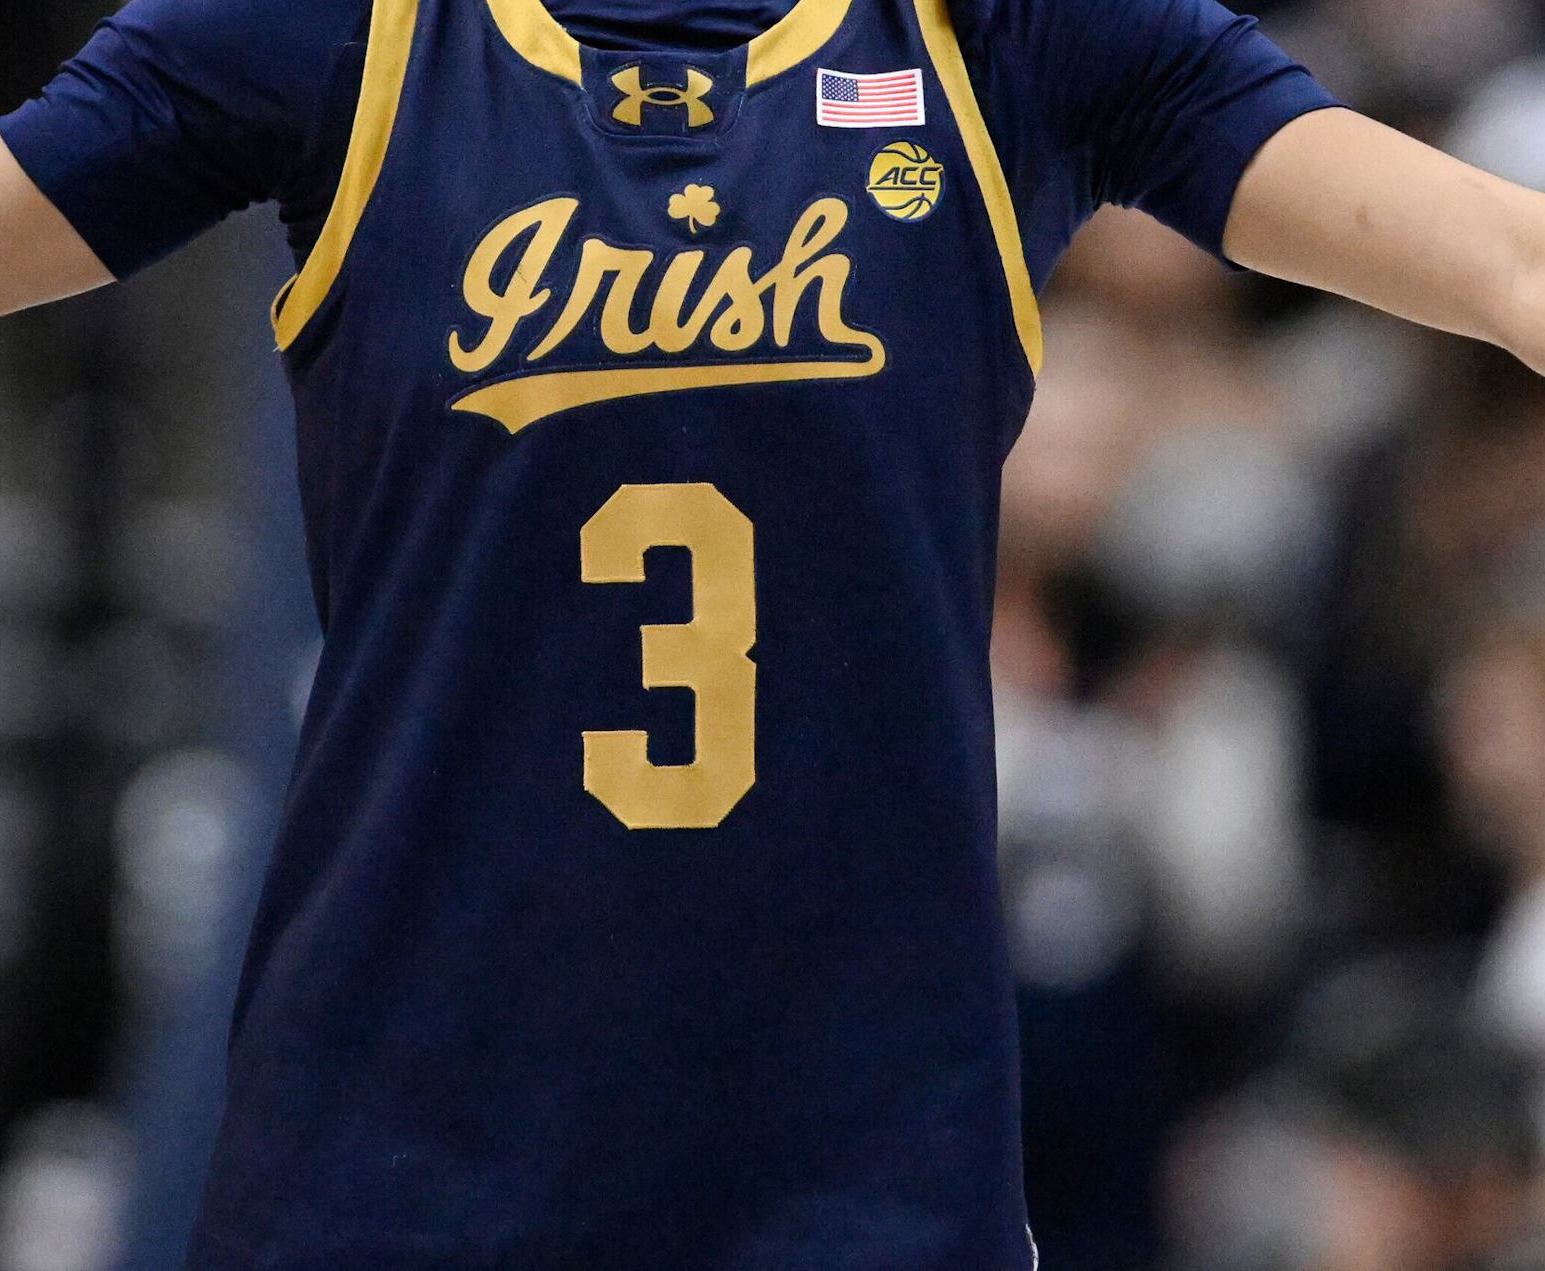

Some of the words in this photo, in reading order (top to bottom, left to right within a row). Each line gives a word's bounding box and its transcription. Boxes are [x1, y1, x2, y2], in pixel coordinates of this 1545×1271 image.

[875, 166, 943, 185] ACC
[449, 197, 886, 435] Irish
[580, 482, 756, 830] 3
